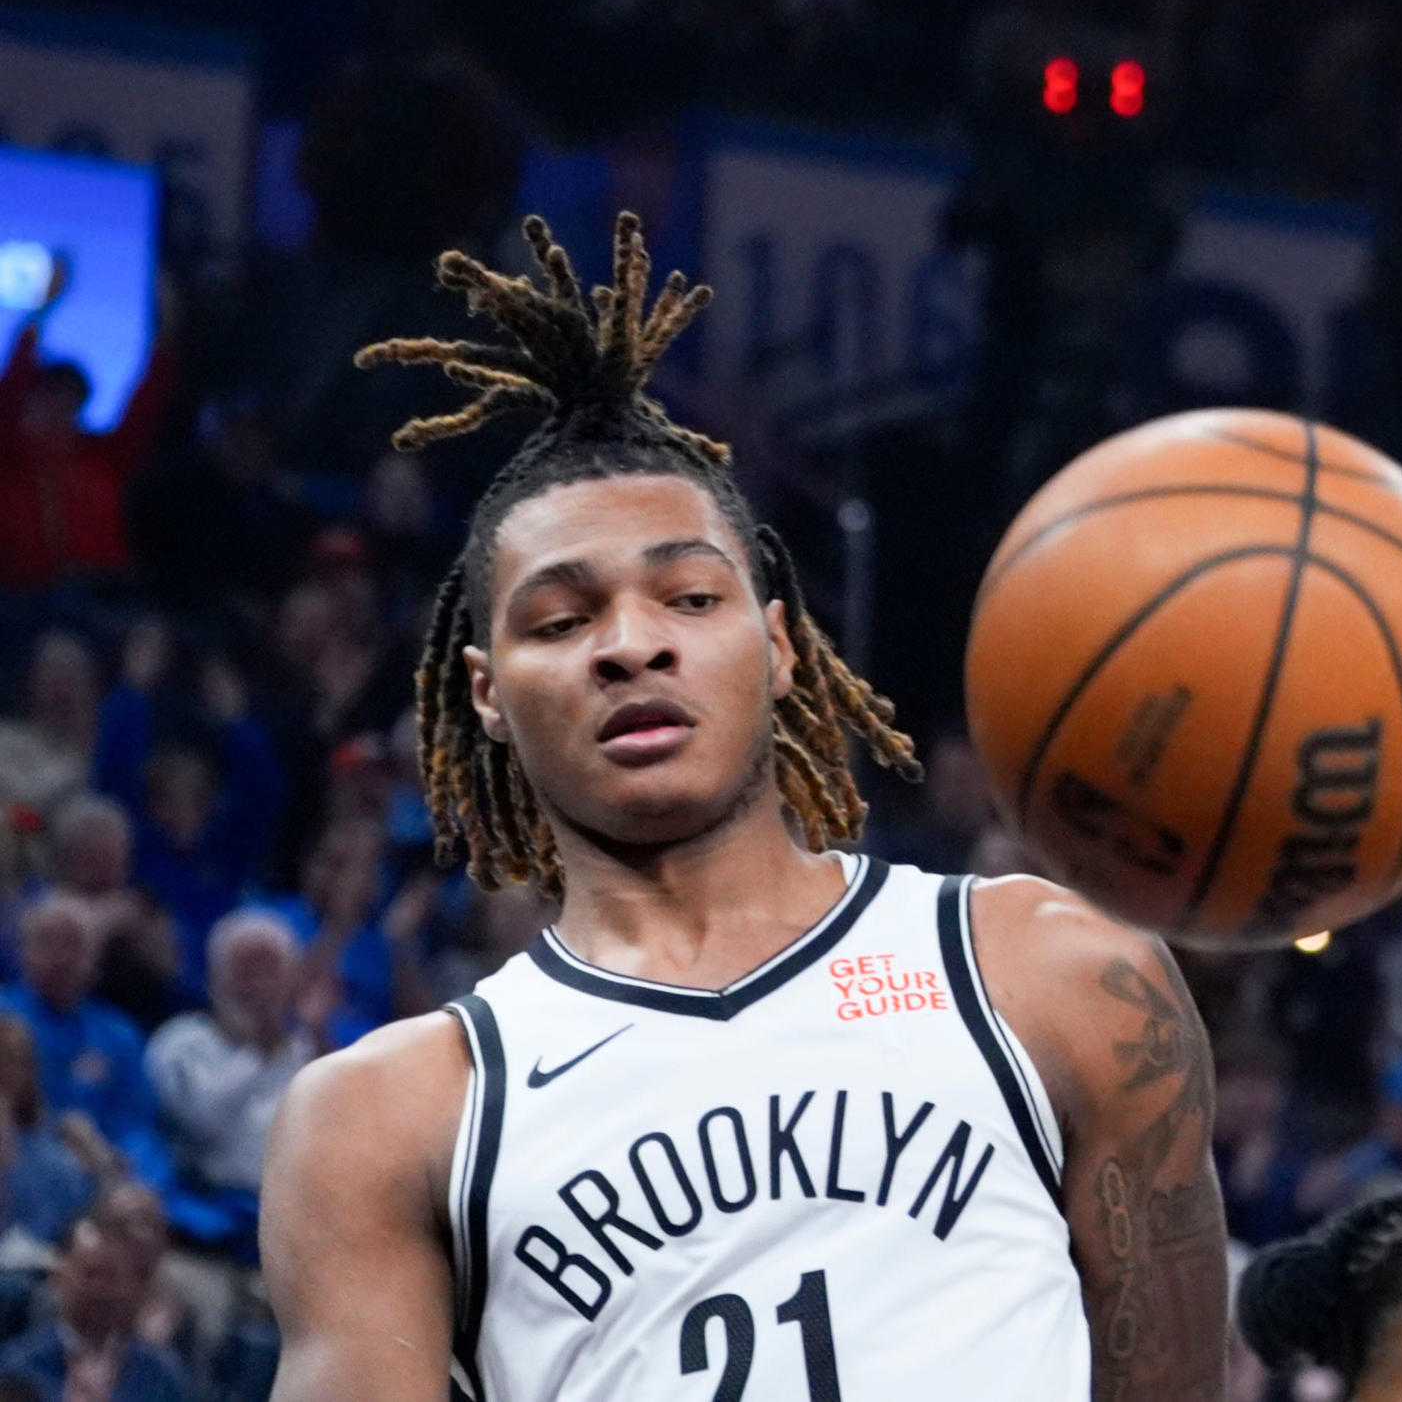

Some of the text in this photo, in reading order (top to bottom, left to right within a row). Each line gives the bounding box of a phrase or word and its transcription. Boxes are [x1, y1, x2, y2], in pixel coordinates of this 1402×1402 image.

[829, 954, 896, 978] GET
[833, 971, 938, 999] YOUR
[837, 991, 949, 1021] GUIDE
[514, 1090, 995, 1322] BROOKLYN
[679, 1268, 842, 1402] 21
